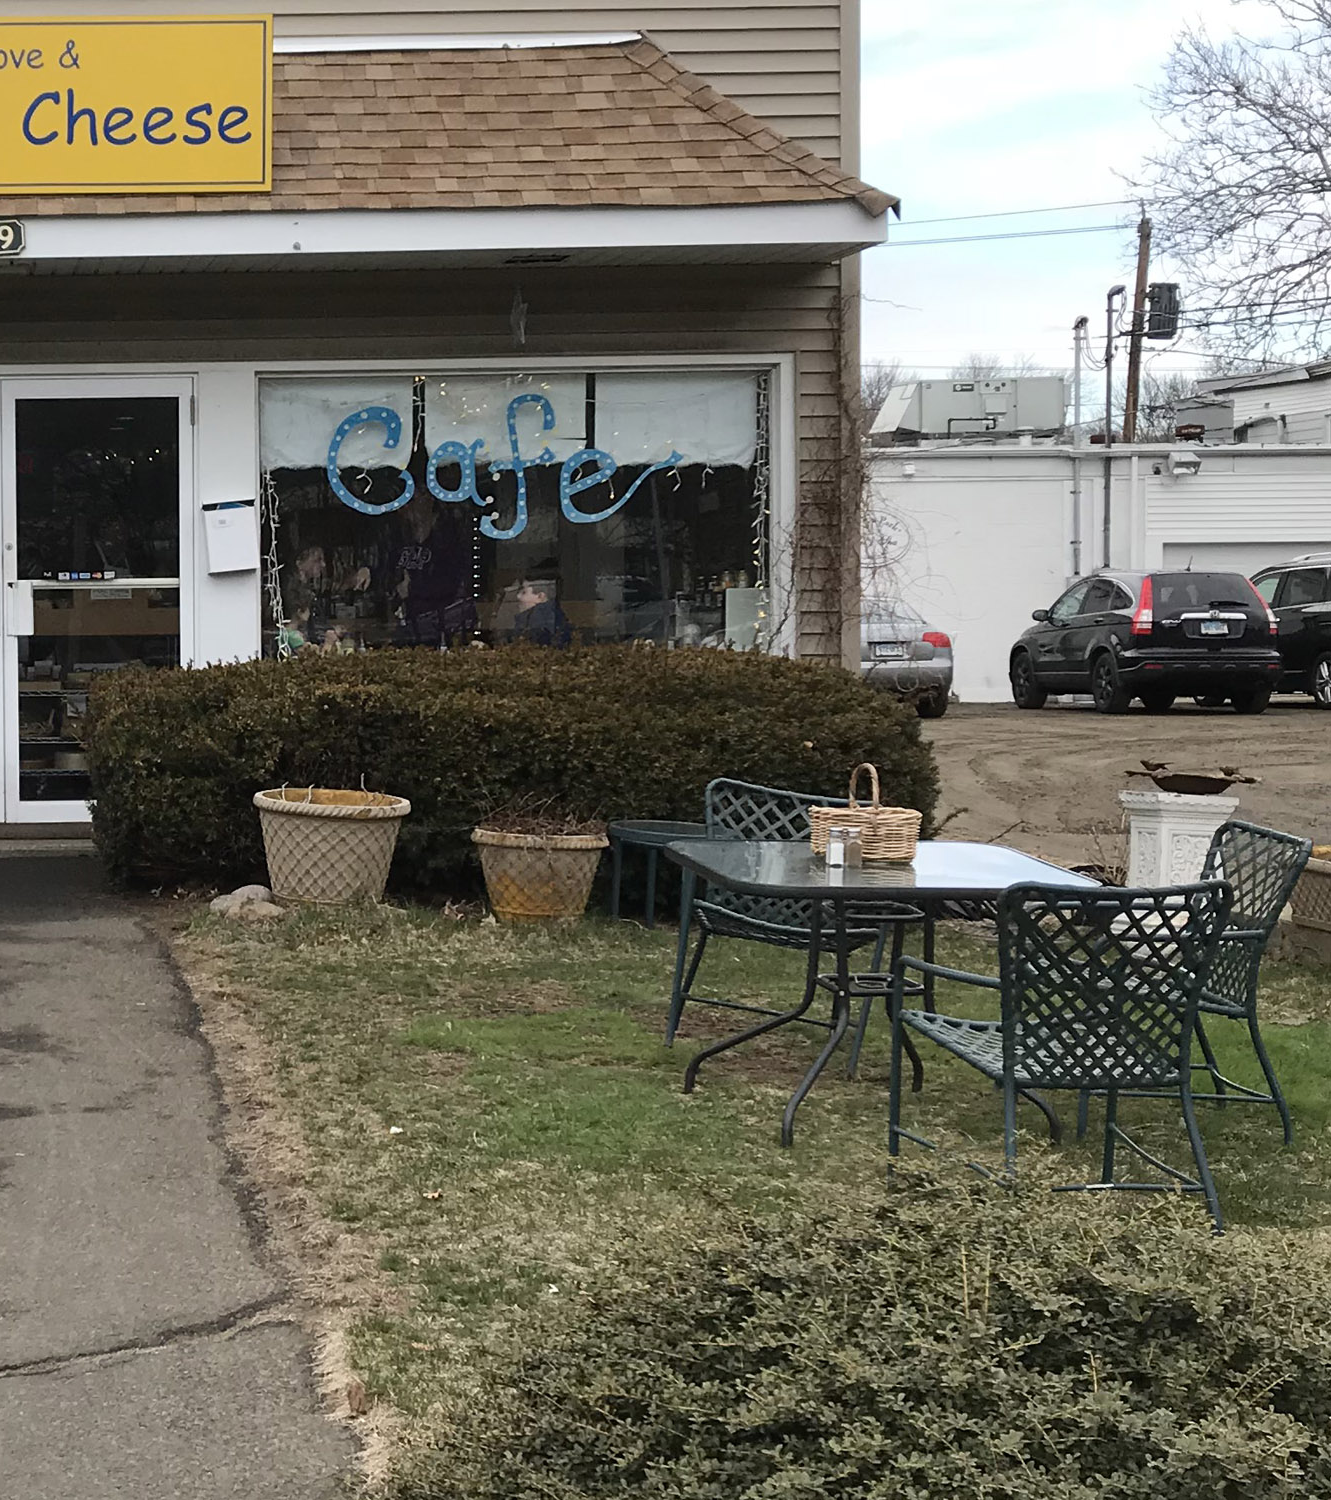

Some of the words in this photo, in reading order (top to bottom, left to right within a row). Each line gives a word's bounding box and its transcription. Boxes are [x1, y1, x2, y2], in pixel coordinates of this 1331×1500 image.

[58, 40, 80, 69] &
[21, 87, 252, 147] Cheese
[327, 393, 684, 540] Cafe
